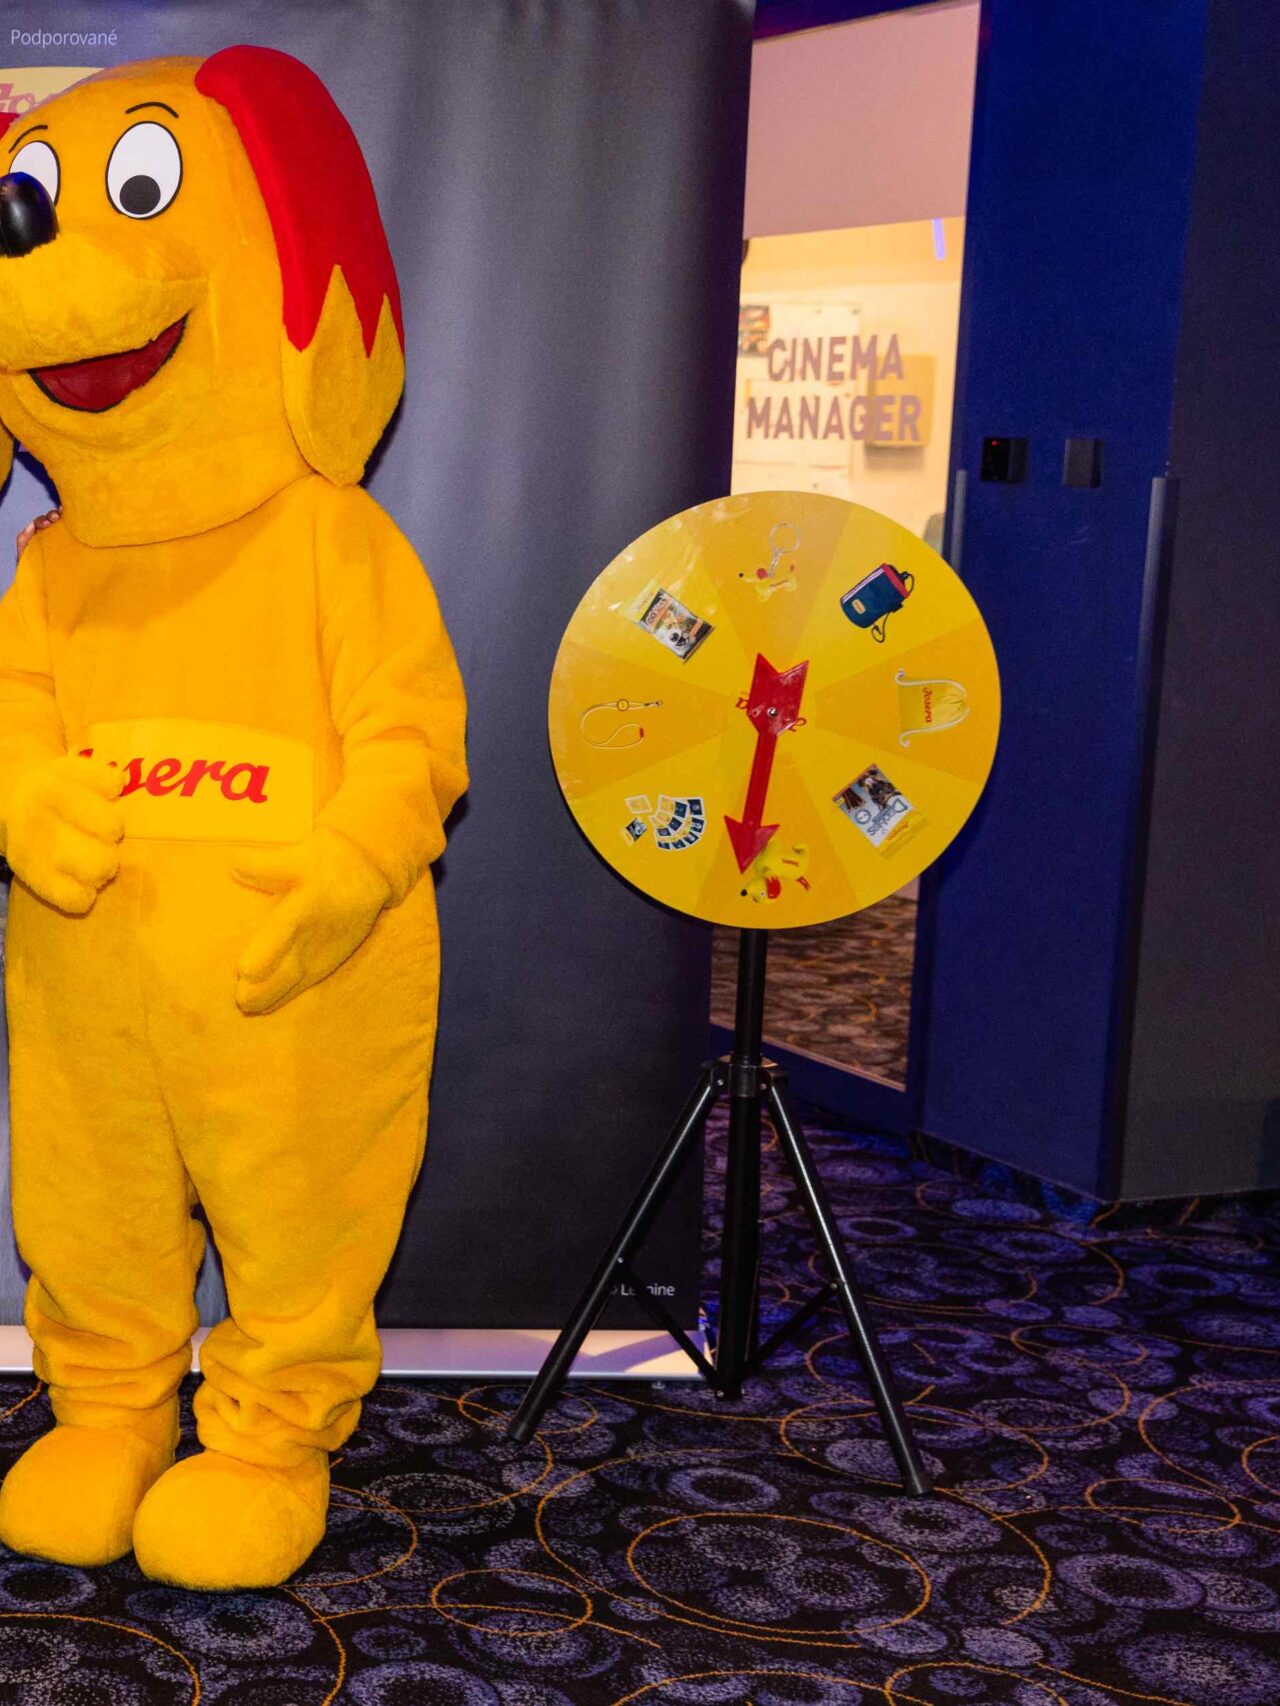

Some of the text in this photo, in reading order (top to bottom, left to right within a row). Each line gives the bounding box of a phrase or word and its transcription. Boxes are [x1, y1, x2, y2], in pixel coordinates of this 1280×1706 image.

[10, 28, 119, 49] Podporované
[767, 333, 905, 382] CINEMA
[746, 394, 922, 441] MANAGER
